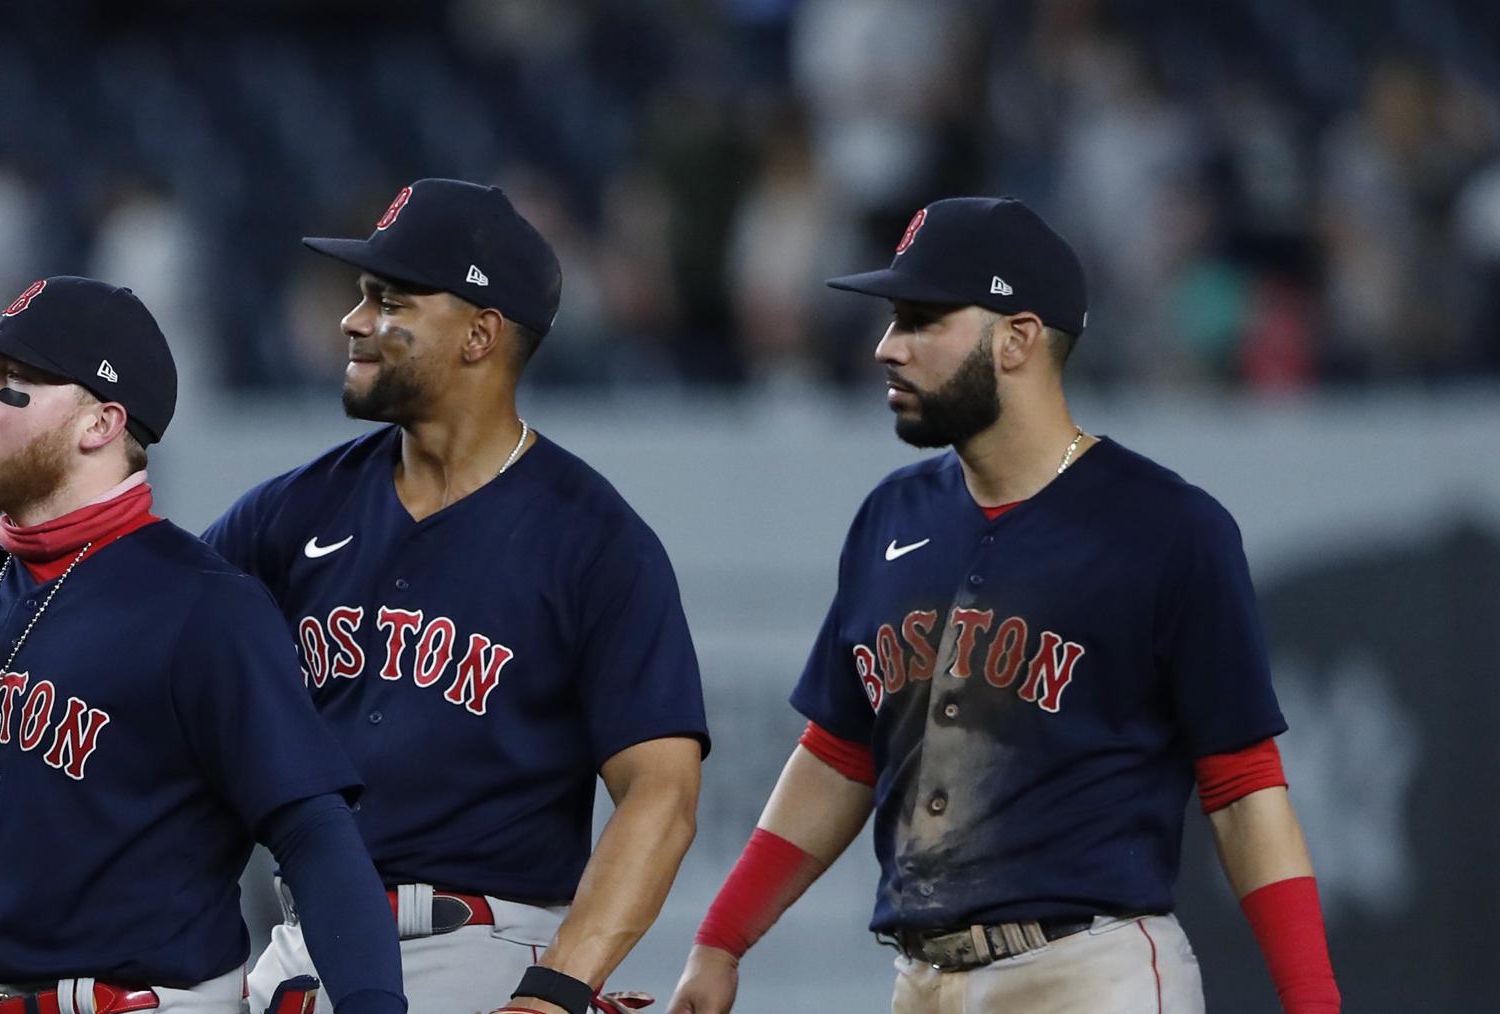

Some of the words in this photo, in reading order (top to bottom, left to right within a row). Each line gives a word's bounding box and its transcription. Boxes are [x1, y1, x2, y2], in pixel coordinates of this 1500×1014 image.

[377, 187, 413, 231] B
[896, 209, 928, 255] B
[2, 280, 47, 317] B
[295, 605, 514, 716] OSTON
[853, 606, 1085, 714] BOSTON
